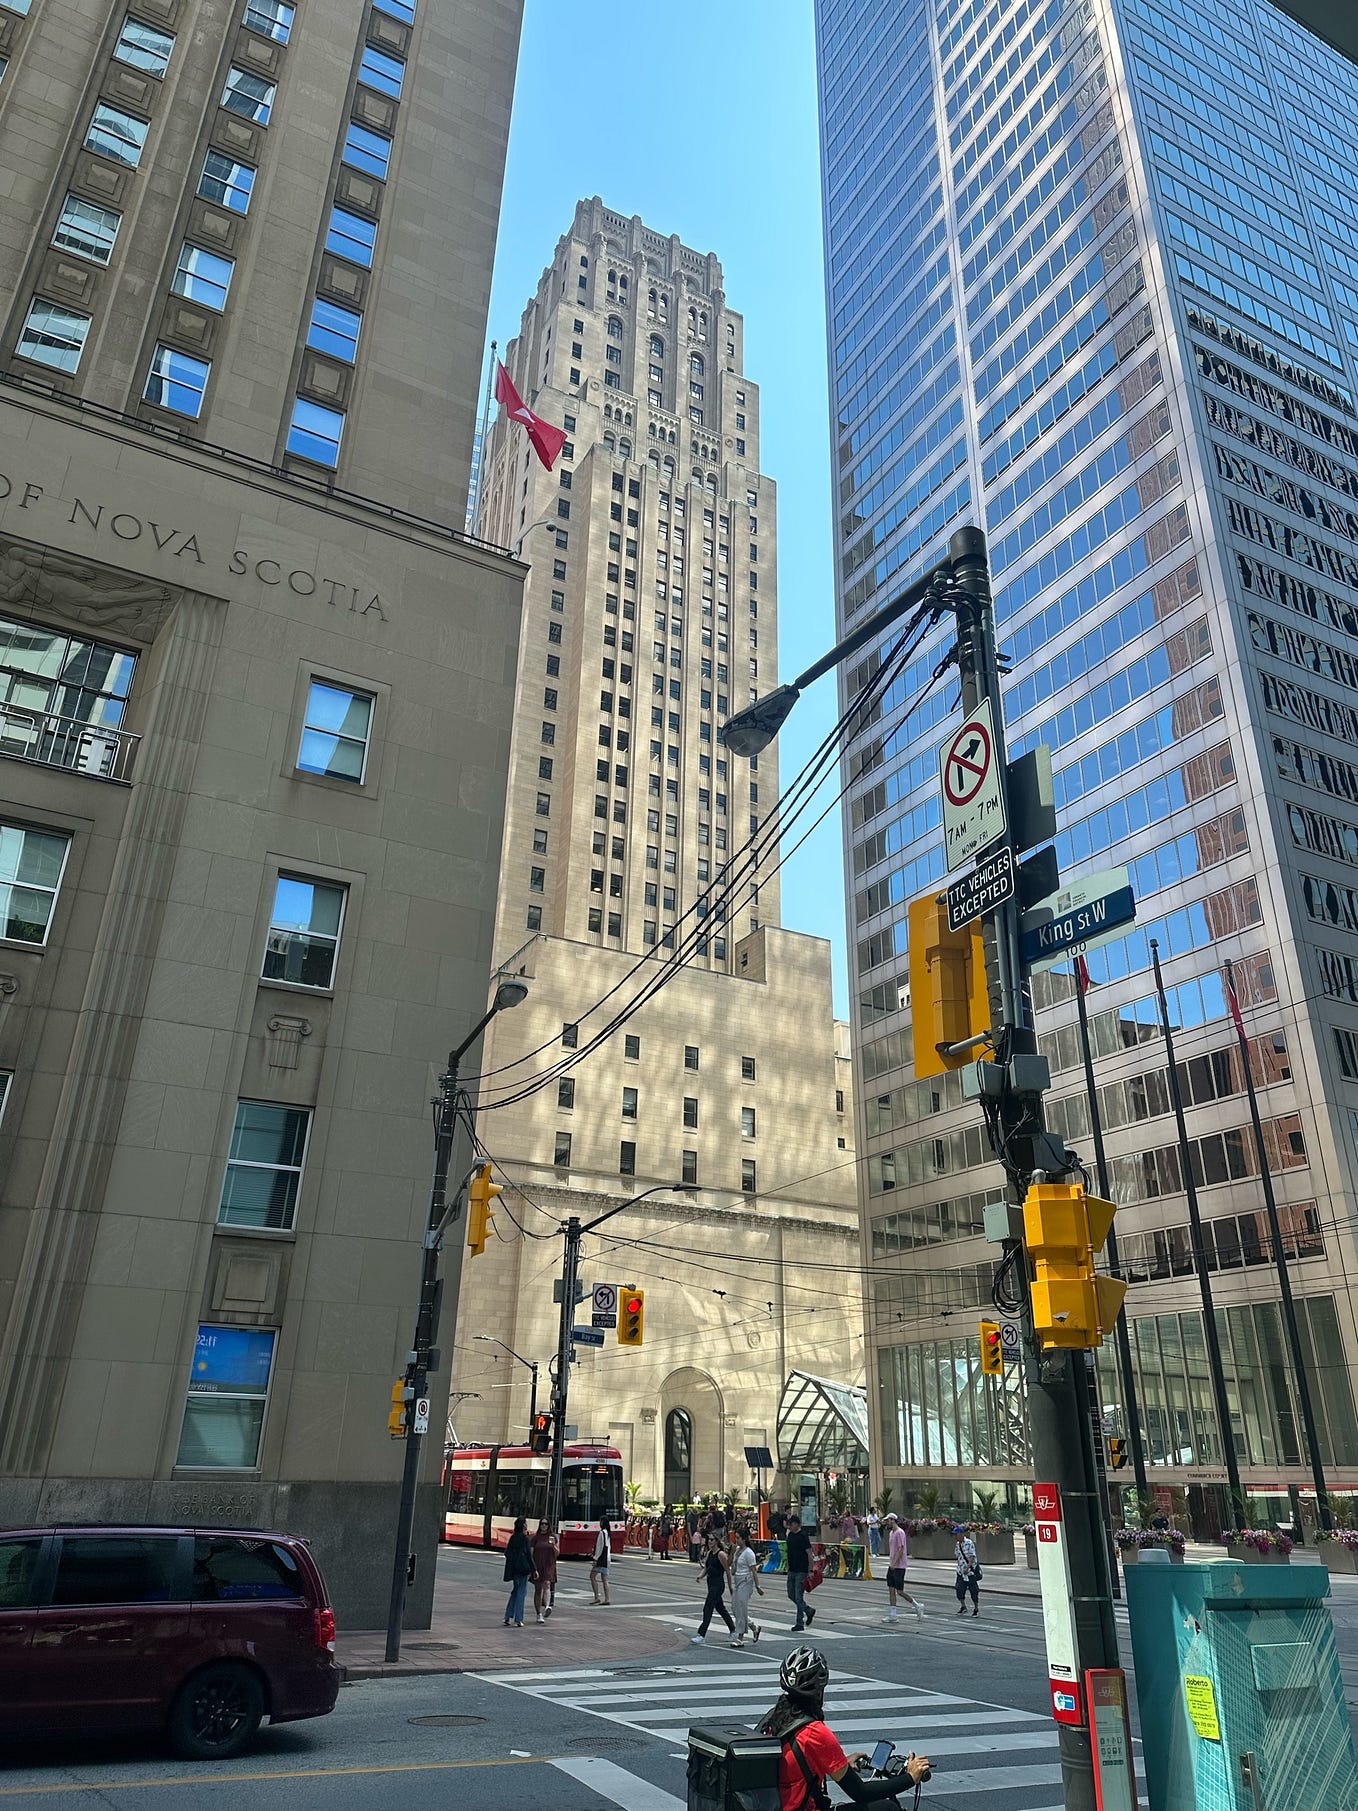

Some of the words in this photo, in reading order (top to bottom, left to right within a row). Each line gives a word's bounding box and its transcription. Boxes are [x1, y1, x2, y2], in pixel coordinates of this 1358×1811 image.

[68, 497, 206, 564] NOVA
[228, 550, 389, 622] SCOTIA
[949, 884, 966, 905] TTC
[969, 855, 1009, 892] VEHICLES
[953, 877, 1008, 923] EXCEPTED
[1038, 918, 1074, 948] King
[1077, 912, 1091, 930] St
[1091, 899, 1106, 923] W
[1065, 941, 1087, 959] 100
[211, 1505, 253, 1516] SCOTIA
[1042, 1527, 1051, 1540] 19
[1186, 1677, 1208, 1687] Roberto
